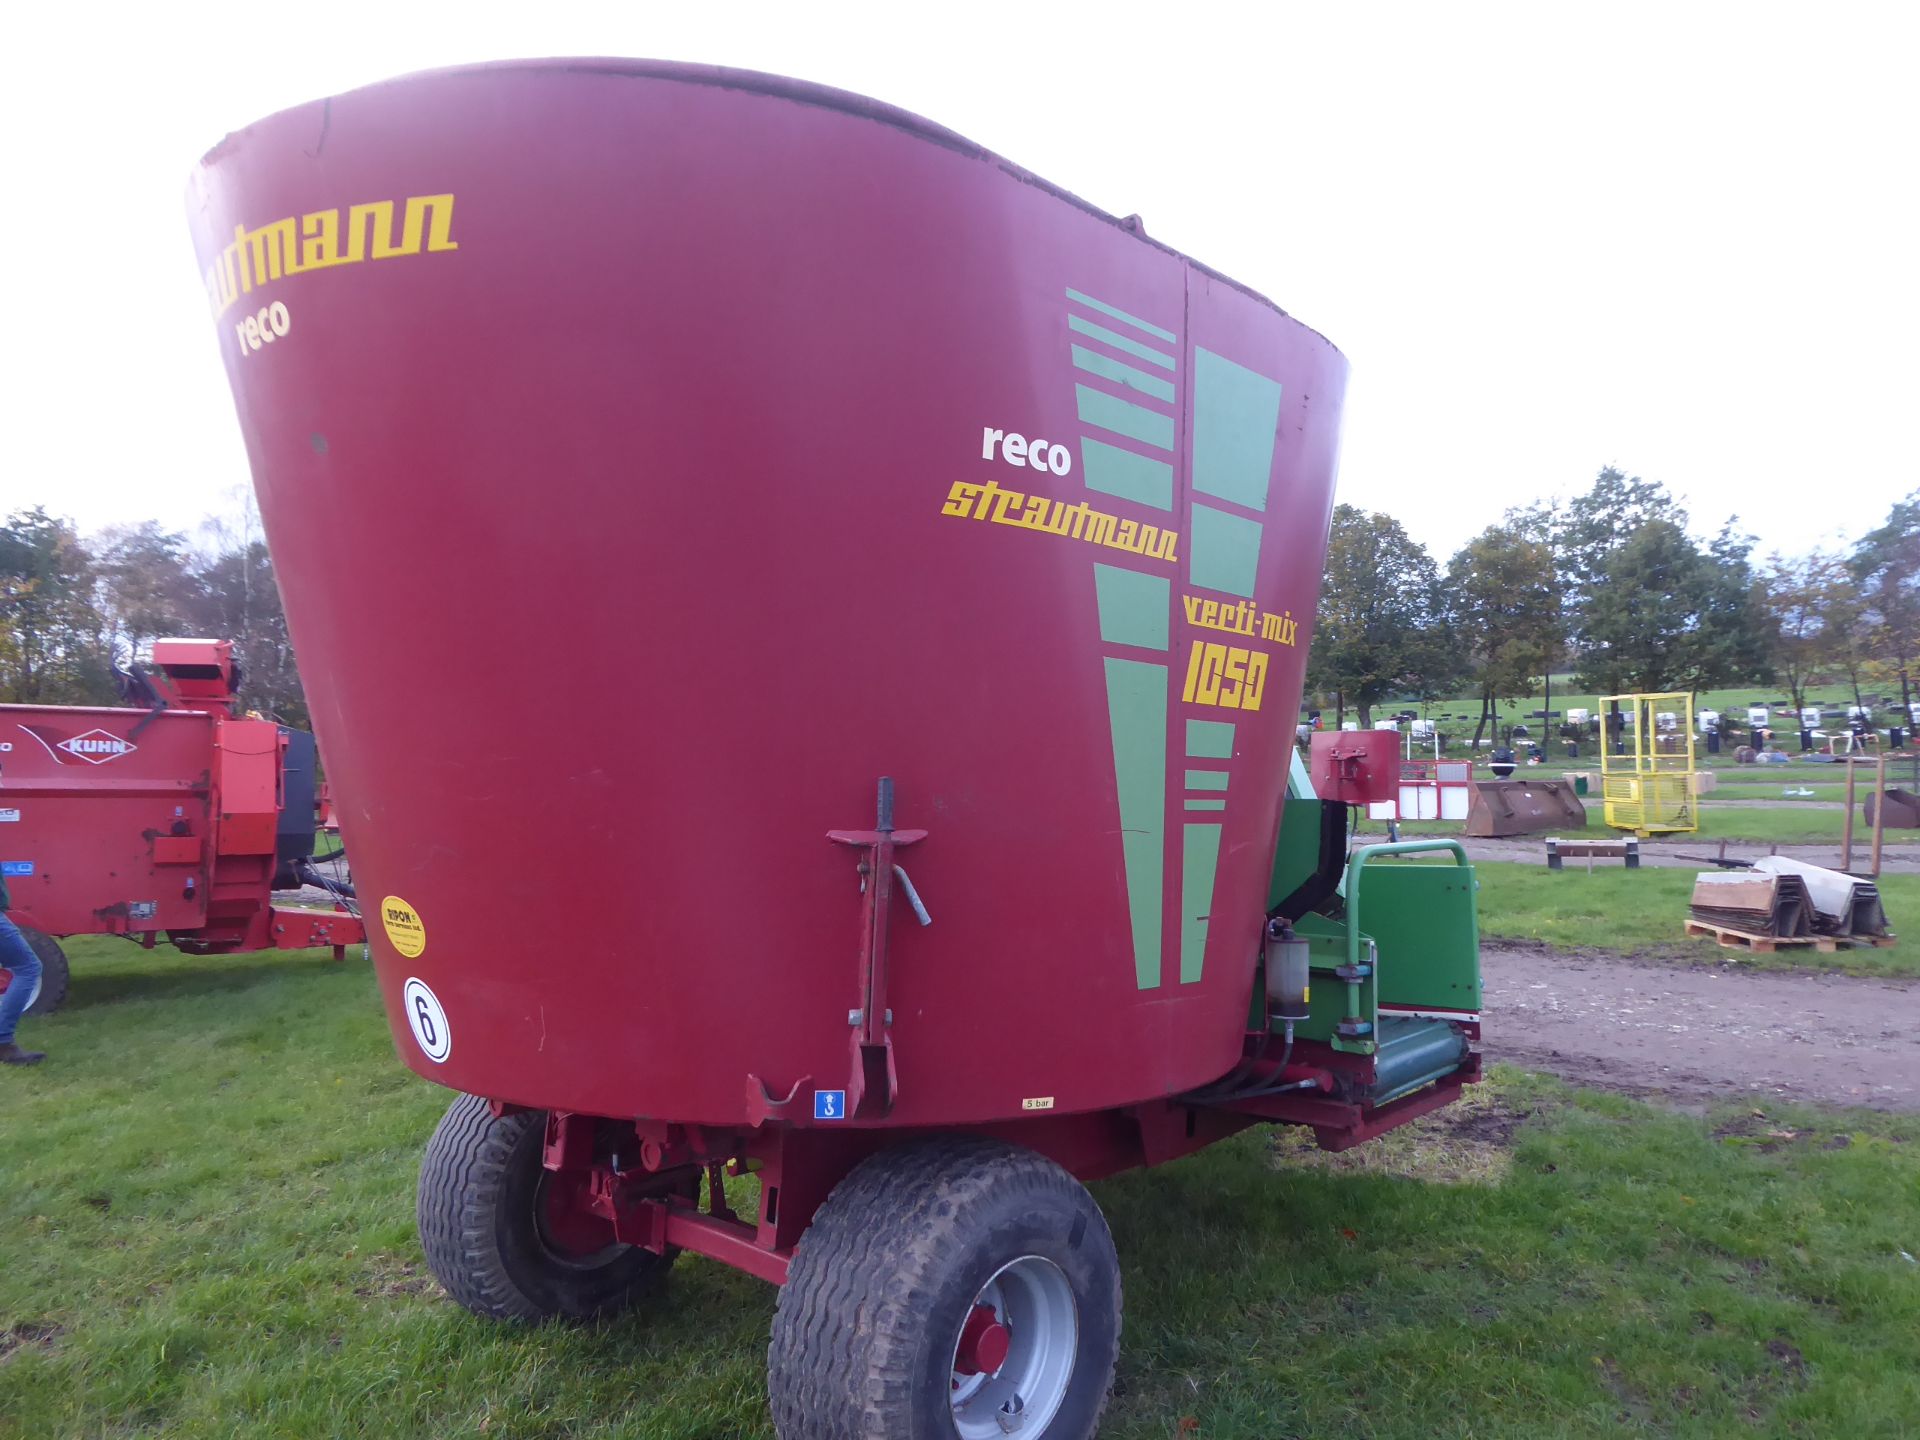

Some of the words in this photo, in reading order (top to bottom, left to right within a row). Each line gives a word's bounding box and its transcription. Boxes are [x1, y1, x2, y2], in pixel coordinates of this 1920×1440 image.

[236, 301, 290, 356] reco
[982, 427, 1072, 476] reco
[941, 480, 1178, 562] strautmann
[1183, 595, 1298, 647] verti-mix
[1182, 640, 1269, 711] 1050
[69, 739, 126, 752] KUHN
[387, 908, 412, 923] RIPON
[415, 995, 437, 1046] 6
[1027, 1100, 1033, 1108] 5
[1036, 1099, 1049, 1107] bar
